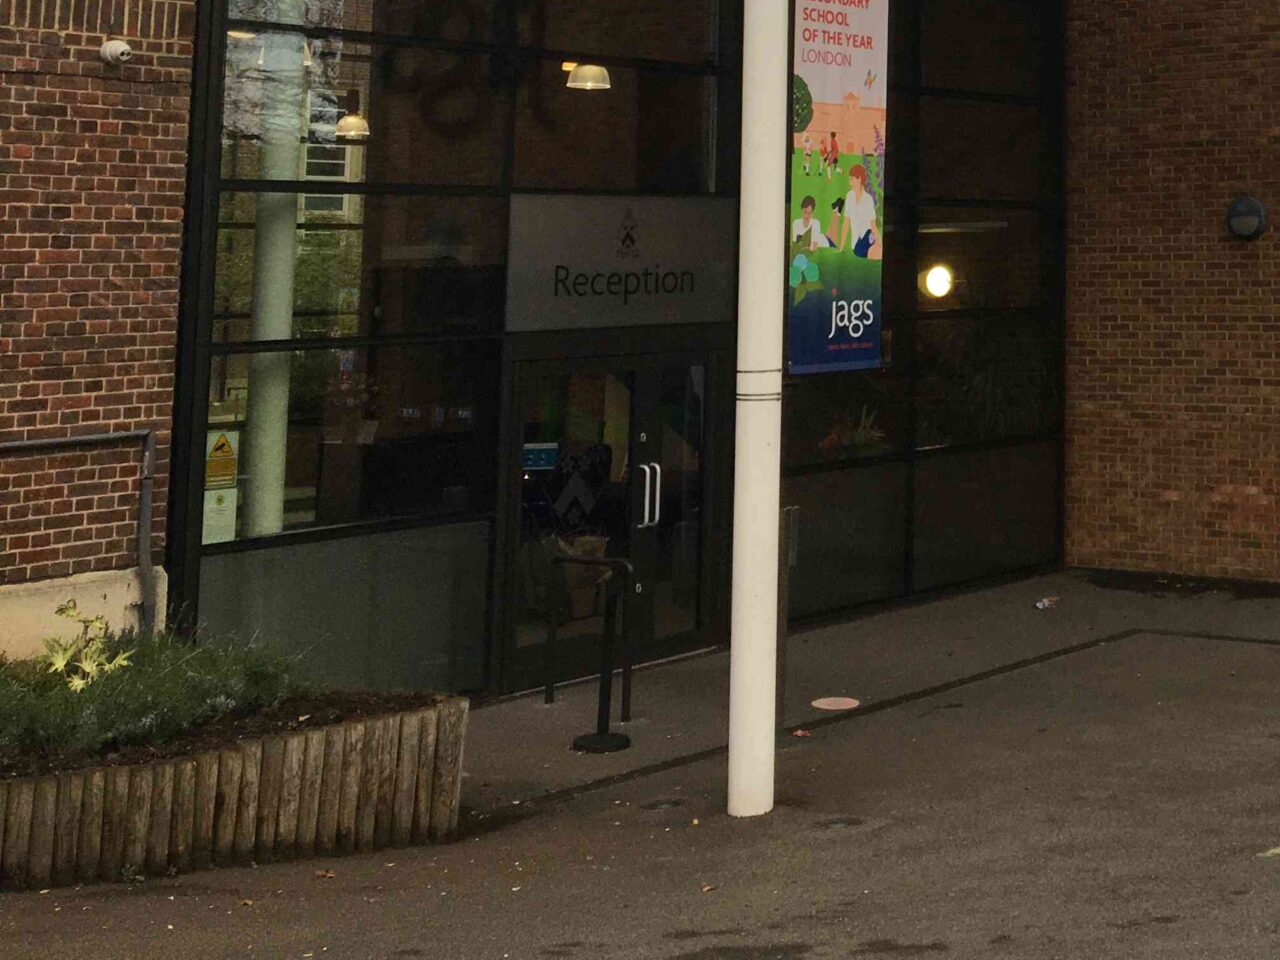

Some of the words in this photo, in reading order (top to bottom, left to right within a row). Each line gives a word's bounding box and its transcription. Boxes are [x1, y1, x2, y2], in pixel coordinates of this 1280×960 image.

[802, 8, 849, 26] SCHOOL
[802, 28, 819, 42] OF
[821, 30, 843, 46] THE
[845, 34, 874, 50] YEAR
[802, 49, 852, 67] LONDON
[554, 264, 695, 305] Reception
[828, 288, 874, 338] jags
